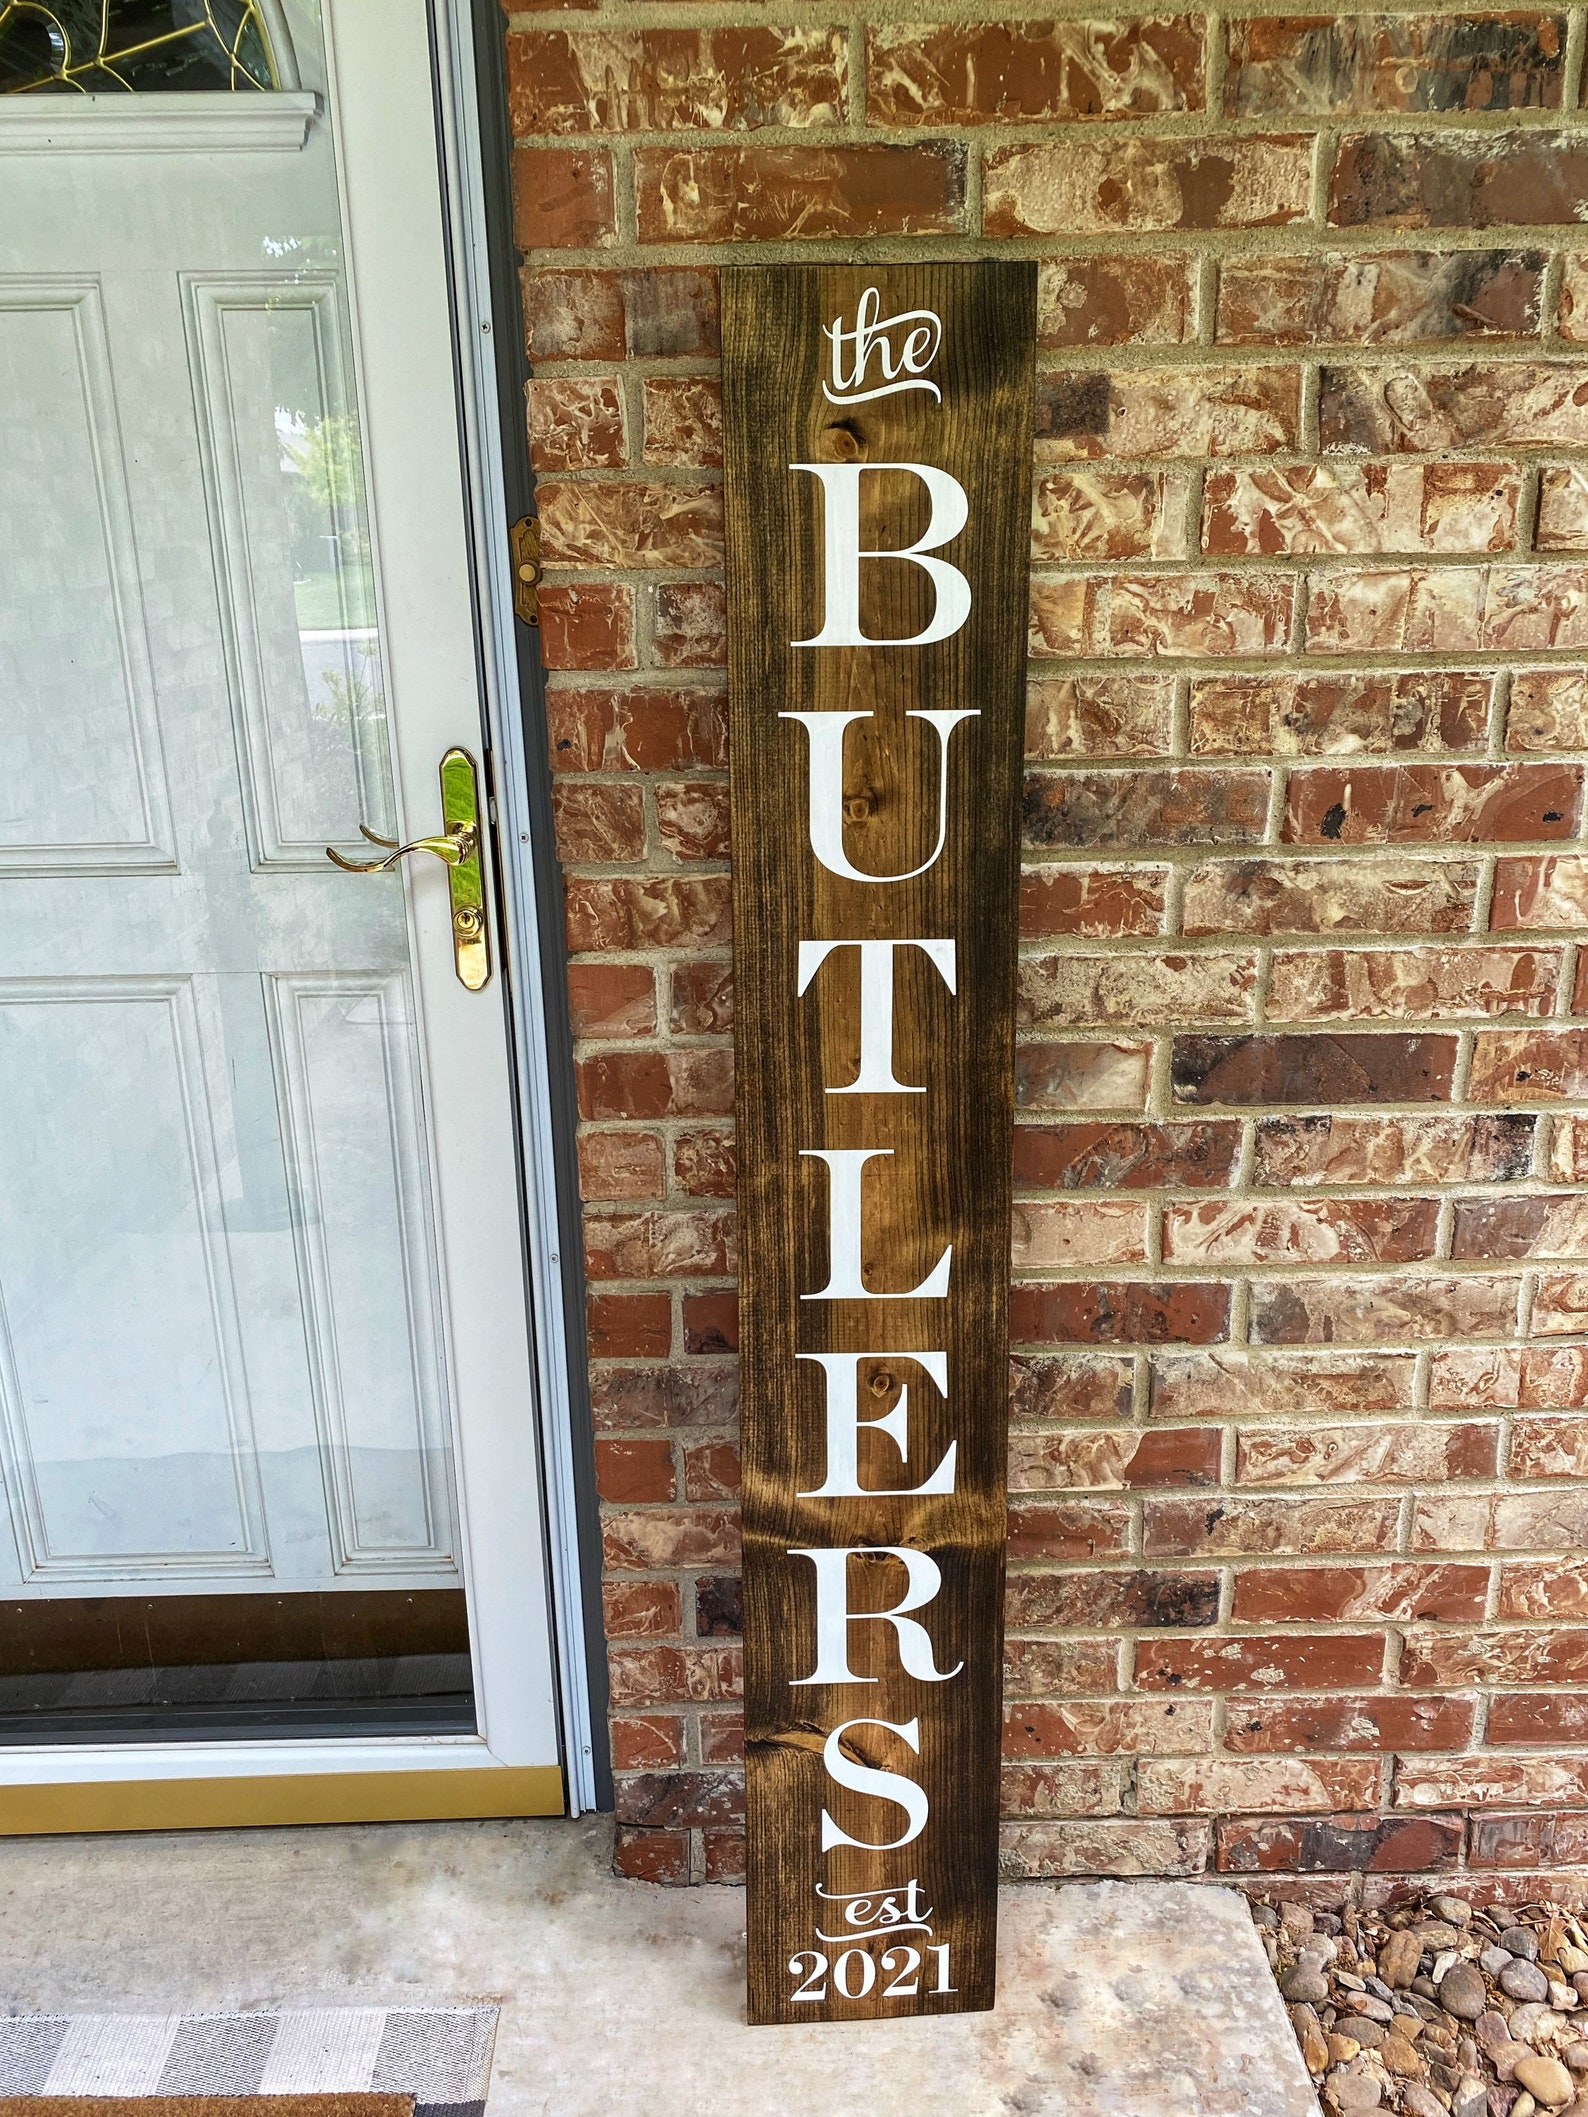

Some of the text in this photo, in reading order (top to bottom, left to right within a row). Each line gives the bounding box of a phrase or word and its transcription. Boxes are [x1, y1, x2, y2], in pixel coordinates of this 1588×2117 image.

[822, 287, 942, 404] the
[778, 463, 981, 1852] BUTLERS
[815, 1879, 933, 1942] est
[788, 1944, 958, 2001] 2021
